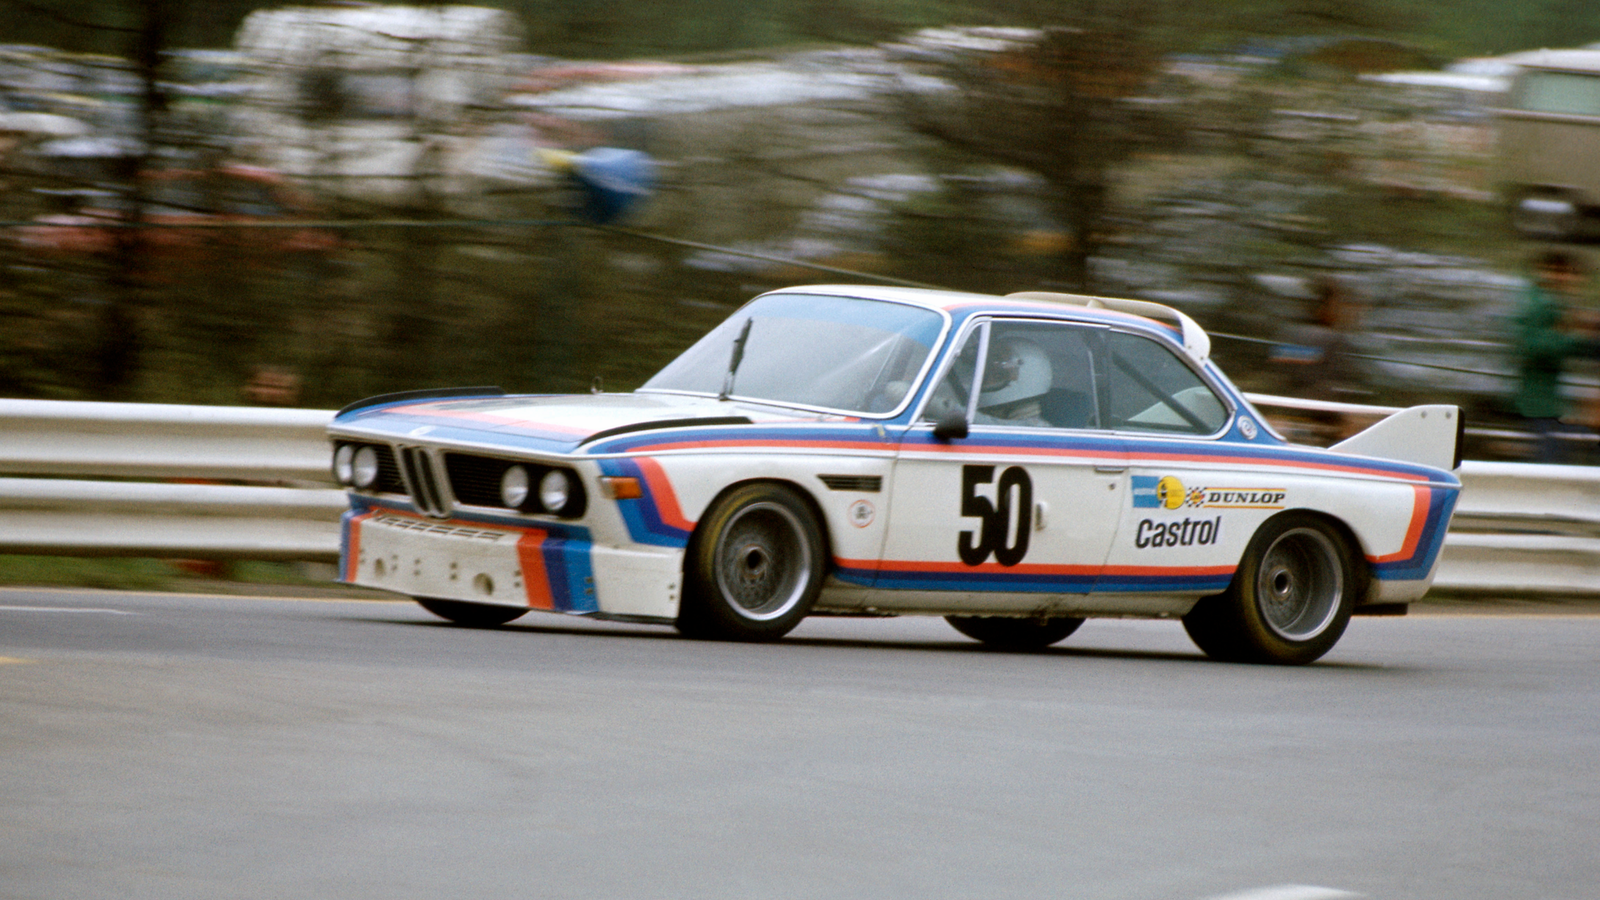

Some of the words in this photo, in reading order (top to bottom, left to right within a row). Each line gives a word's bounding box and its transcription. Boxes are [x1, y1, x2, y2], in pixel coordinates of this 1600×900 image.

[1207, 491, 1286, 504] DUNLOP
[958, 465, 1033, 567] 50
[1135, 515, 1222, 549] Castrol
